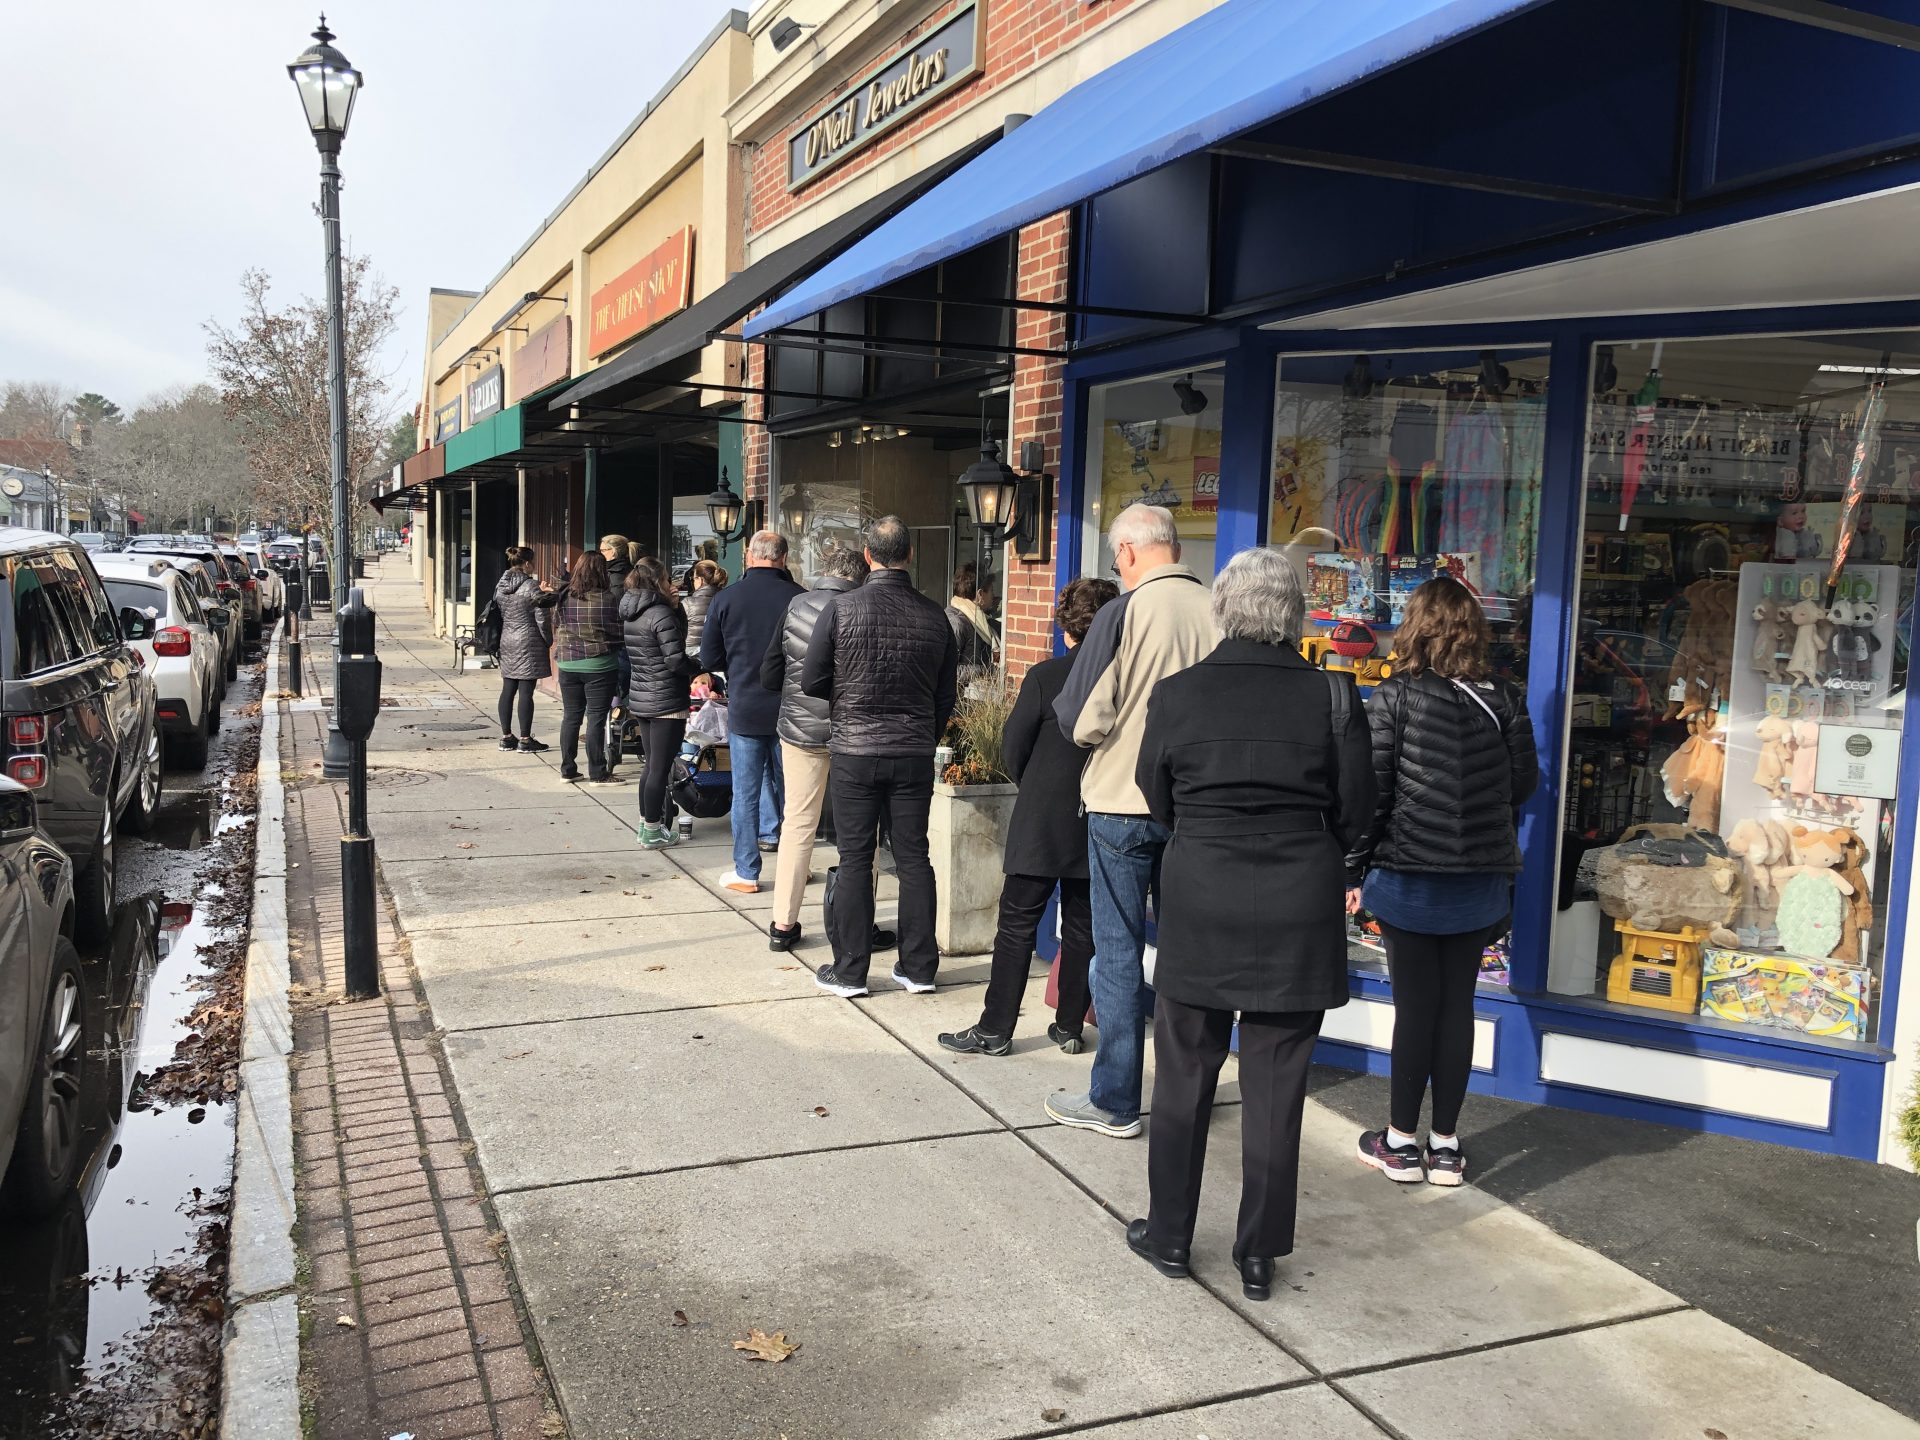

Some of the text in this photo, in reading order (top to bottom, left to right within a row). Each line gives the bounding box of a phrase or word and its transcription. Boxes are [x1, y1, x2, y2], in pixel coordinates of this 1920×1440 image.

[805, 48, 945, 167] O'Neil Jewelers
[596, 258, 678, 335] THE CHEESE SHOP
[1196, 472, 1219, 495] LEG
